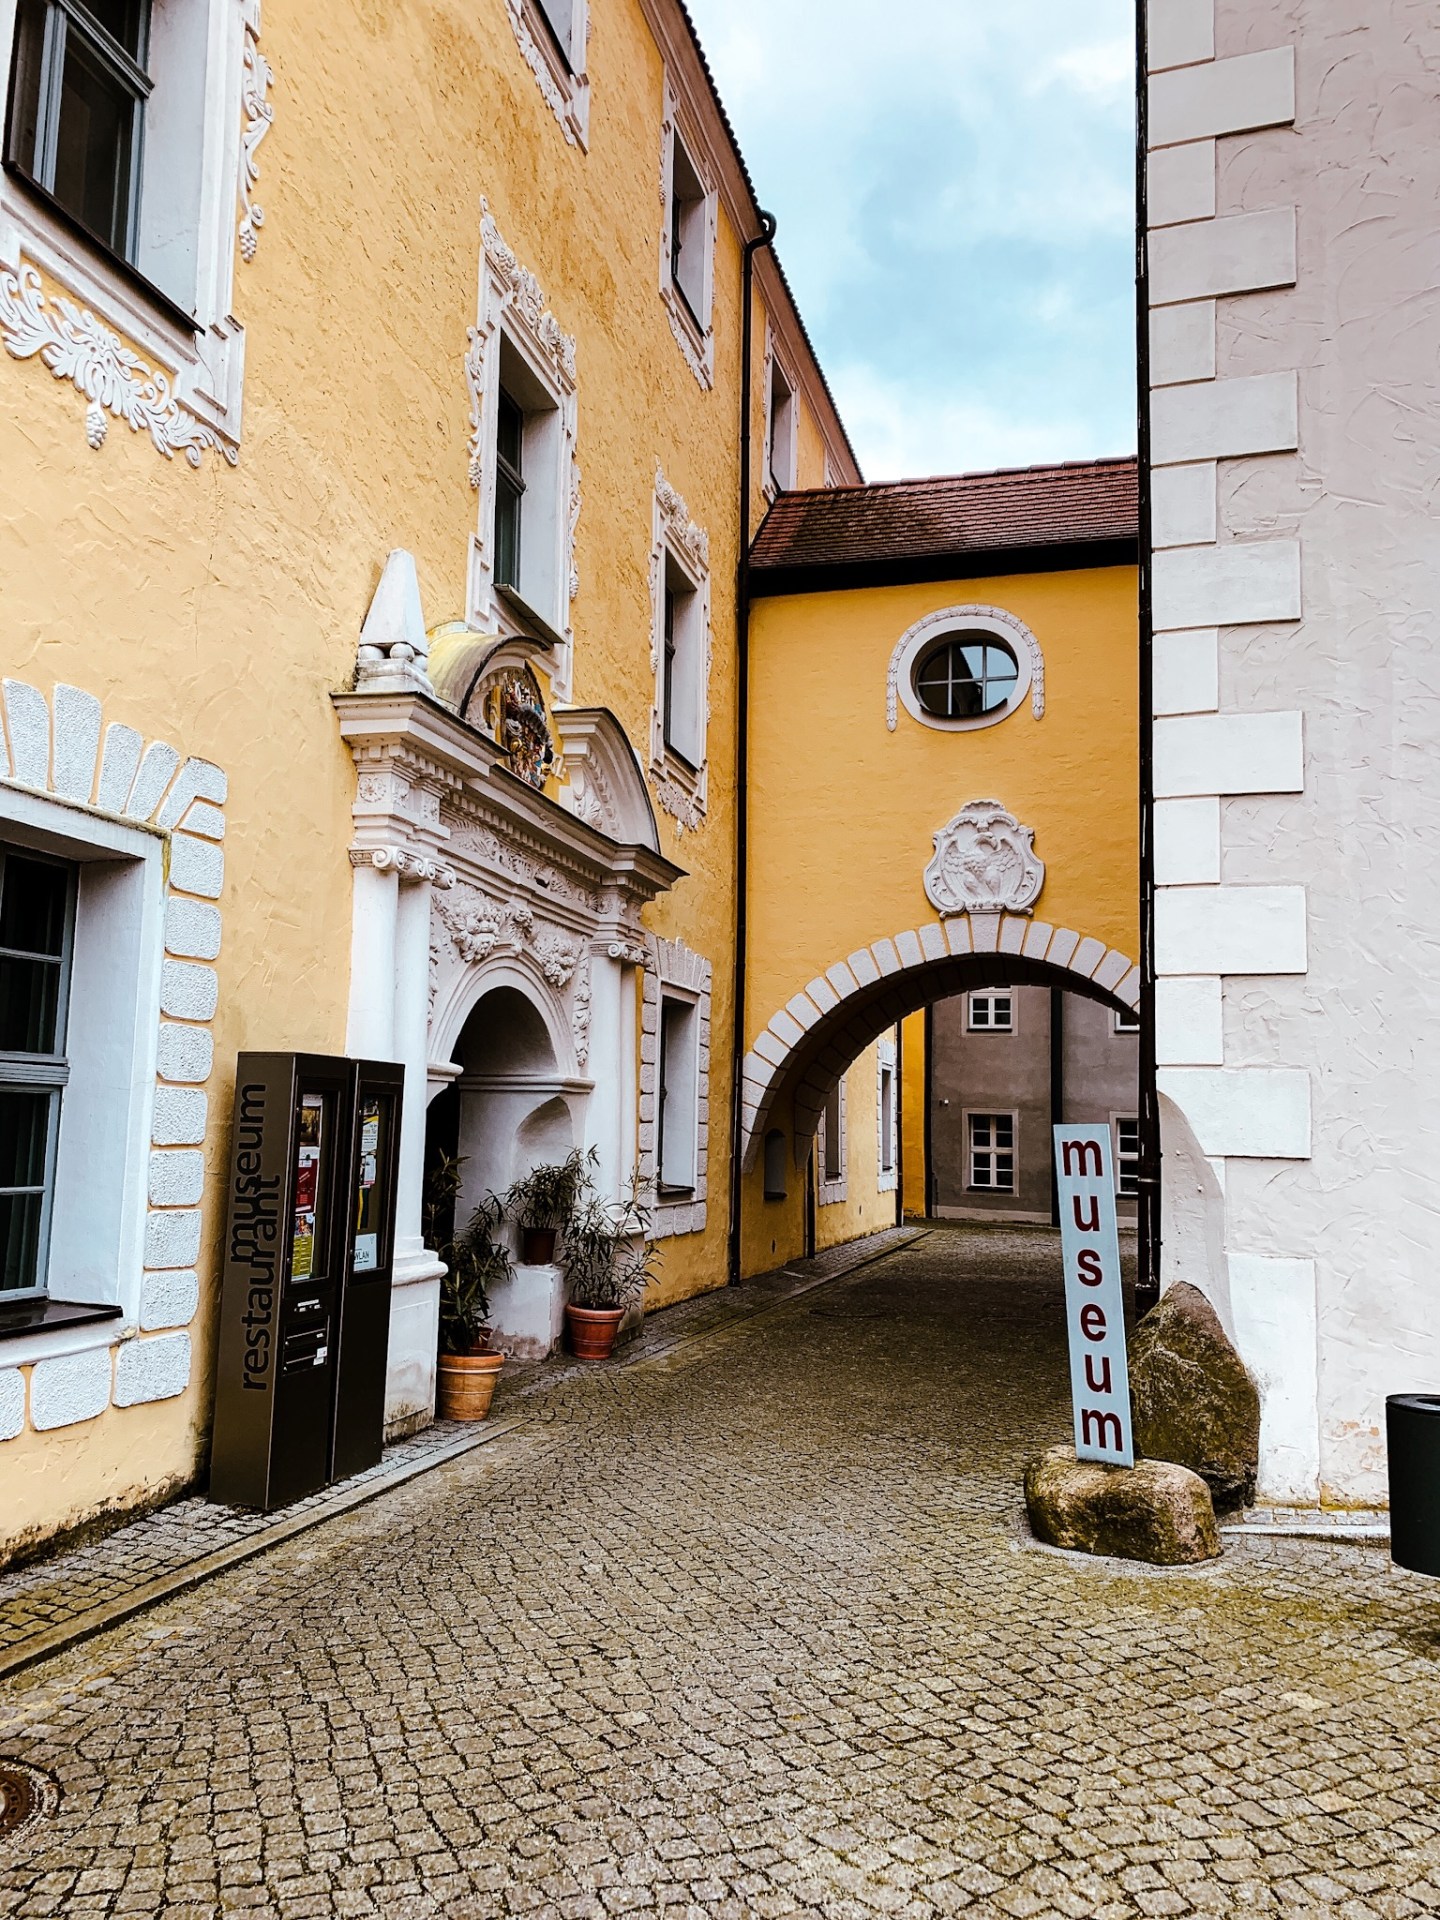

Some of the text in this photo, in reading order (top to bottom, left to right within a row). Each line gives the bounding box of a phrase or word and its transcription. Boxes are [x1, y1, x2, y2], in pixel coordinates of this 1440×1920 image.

[231, 1084, 266, 1263] museum
[240, 1174, 281, 1391] restaurant
[1061, 1139, 1124, 1452] museum
